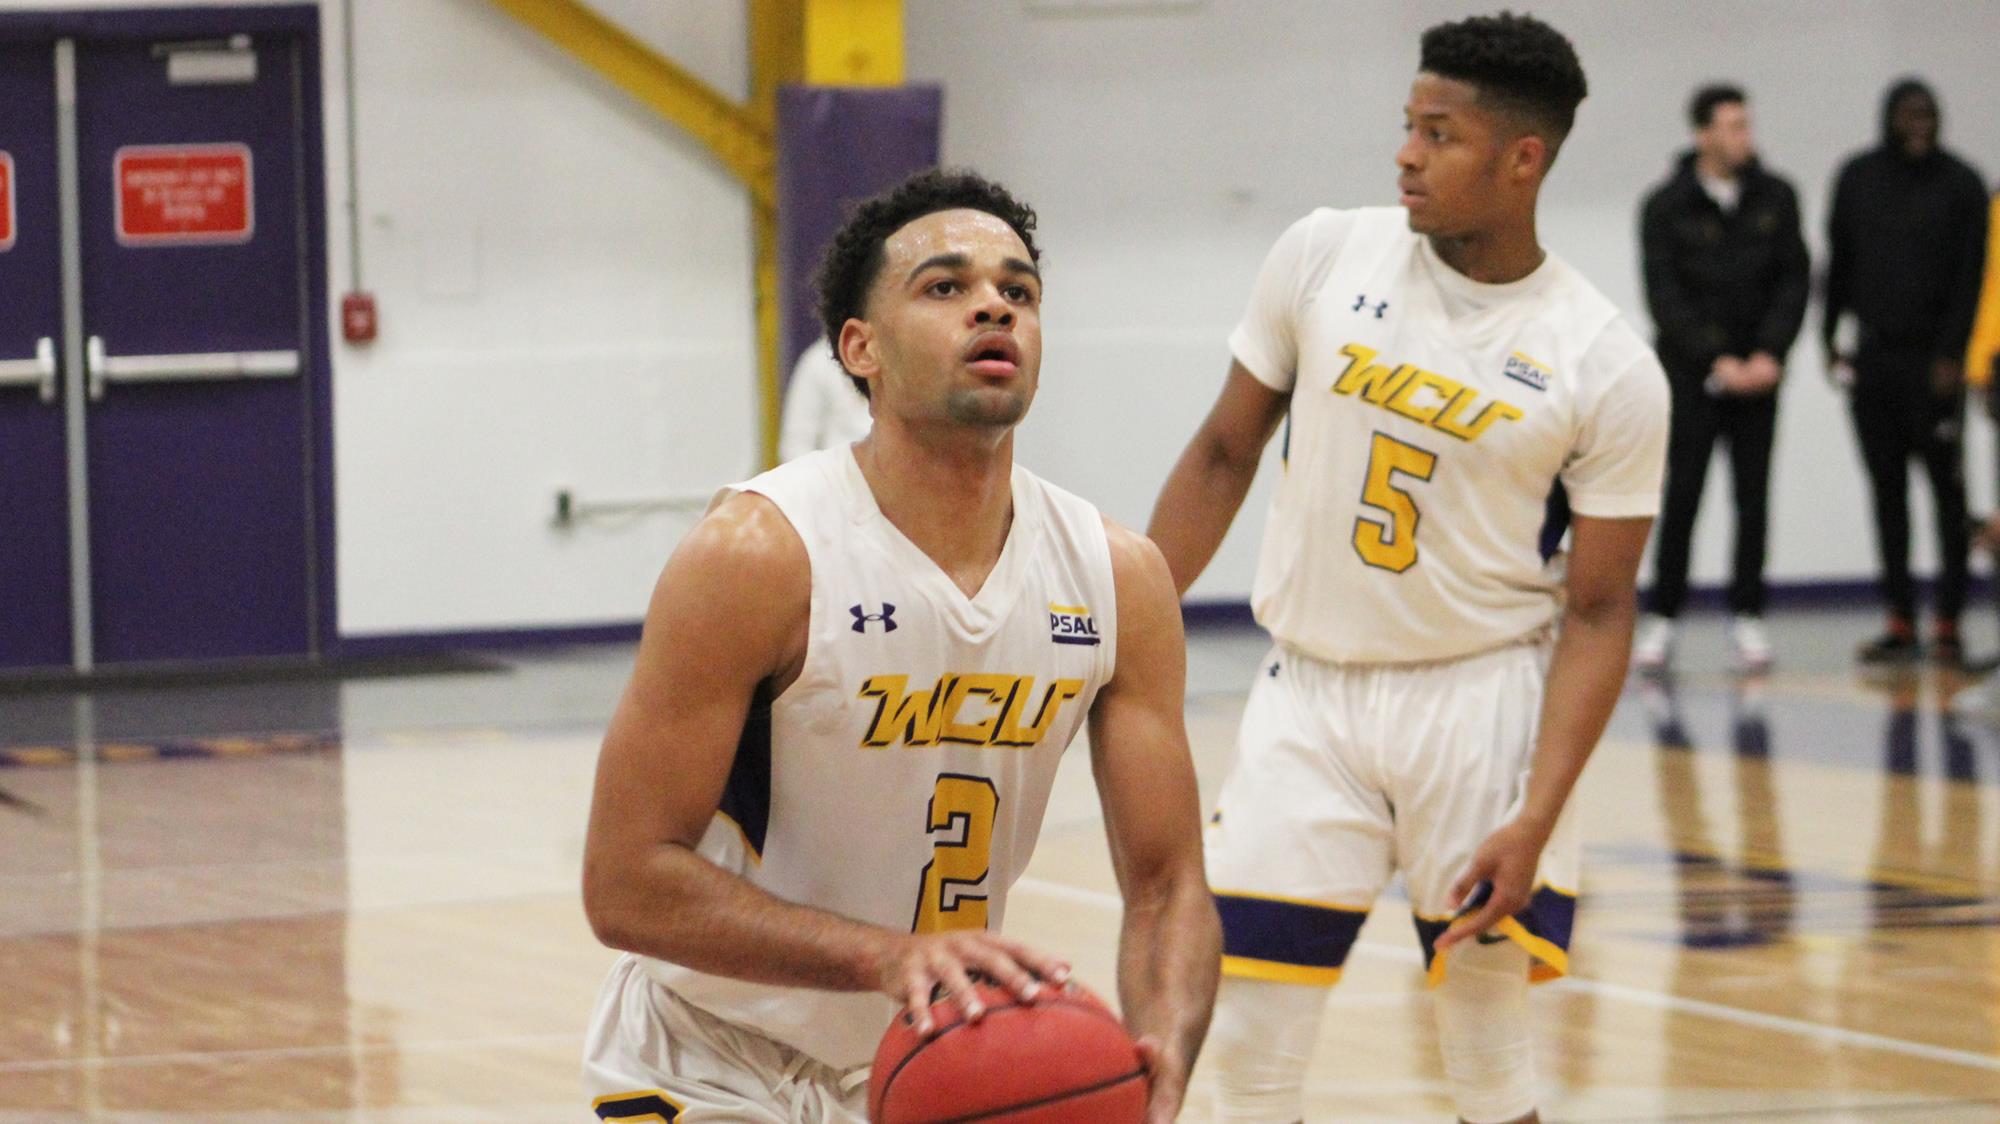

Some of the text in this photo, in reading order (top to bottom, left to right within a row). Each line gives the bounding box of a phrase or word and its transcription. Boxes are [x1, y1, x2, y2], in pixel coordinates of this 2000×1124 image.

[1332, 344, 1524, 441] WCU
[1507, 357, 1552, 385] PSAC
[1352, 430, 1438, 574] 5
[859, 673, 1085, 747] WCU
[911, 773, 999, 934] 2
